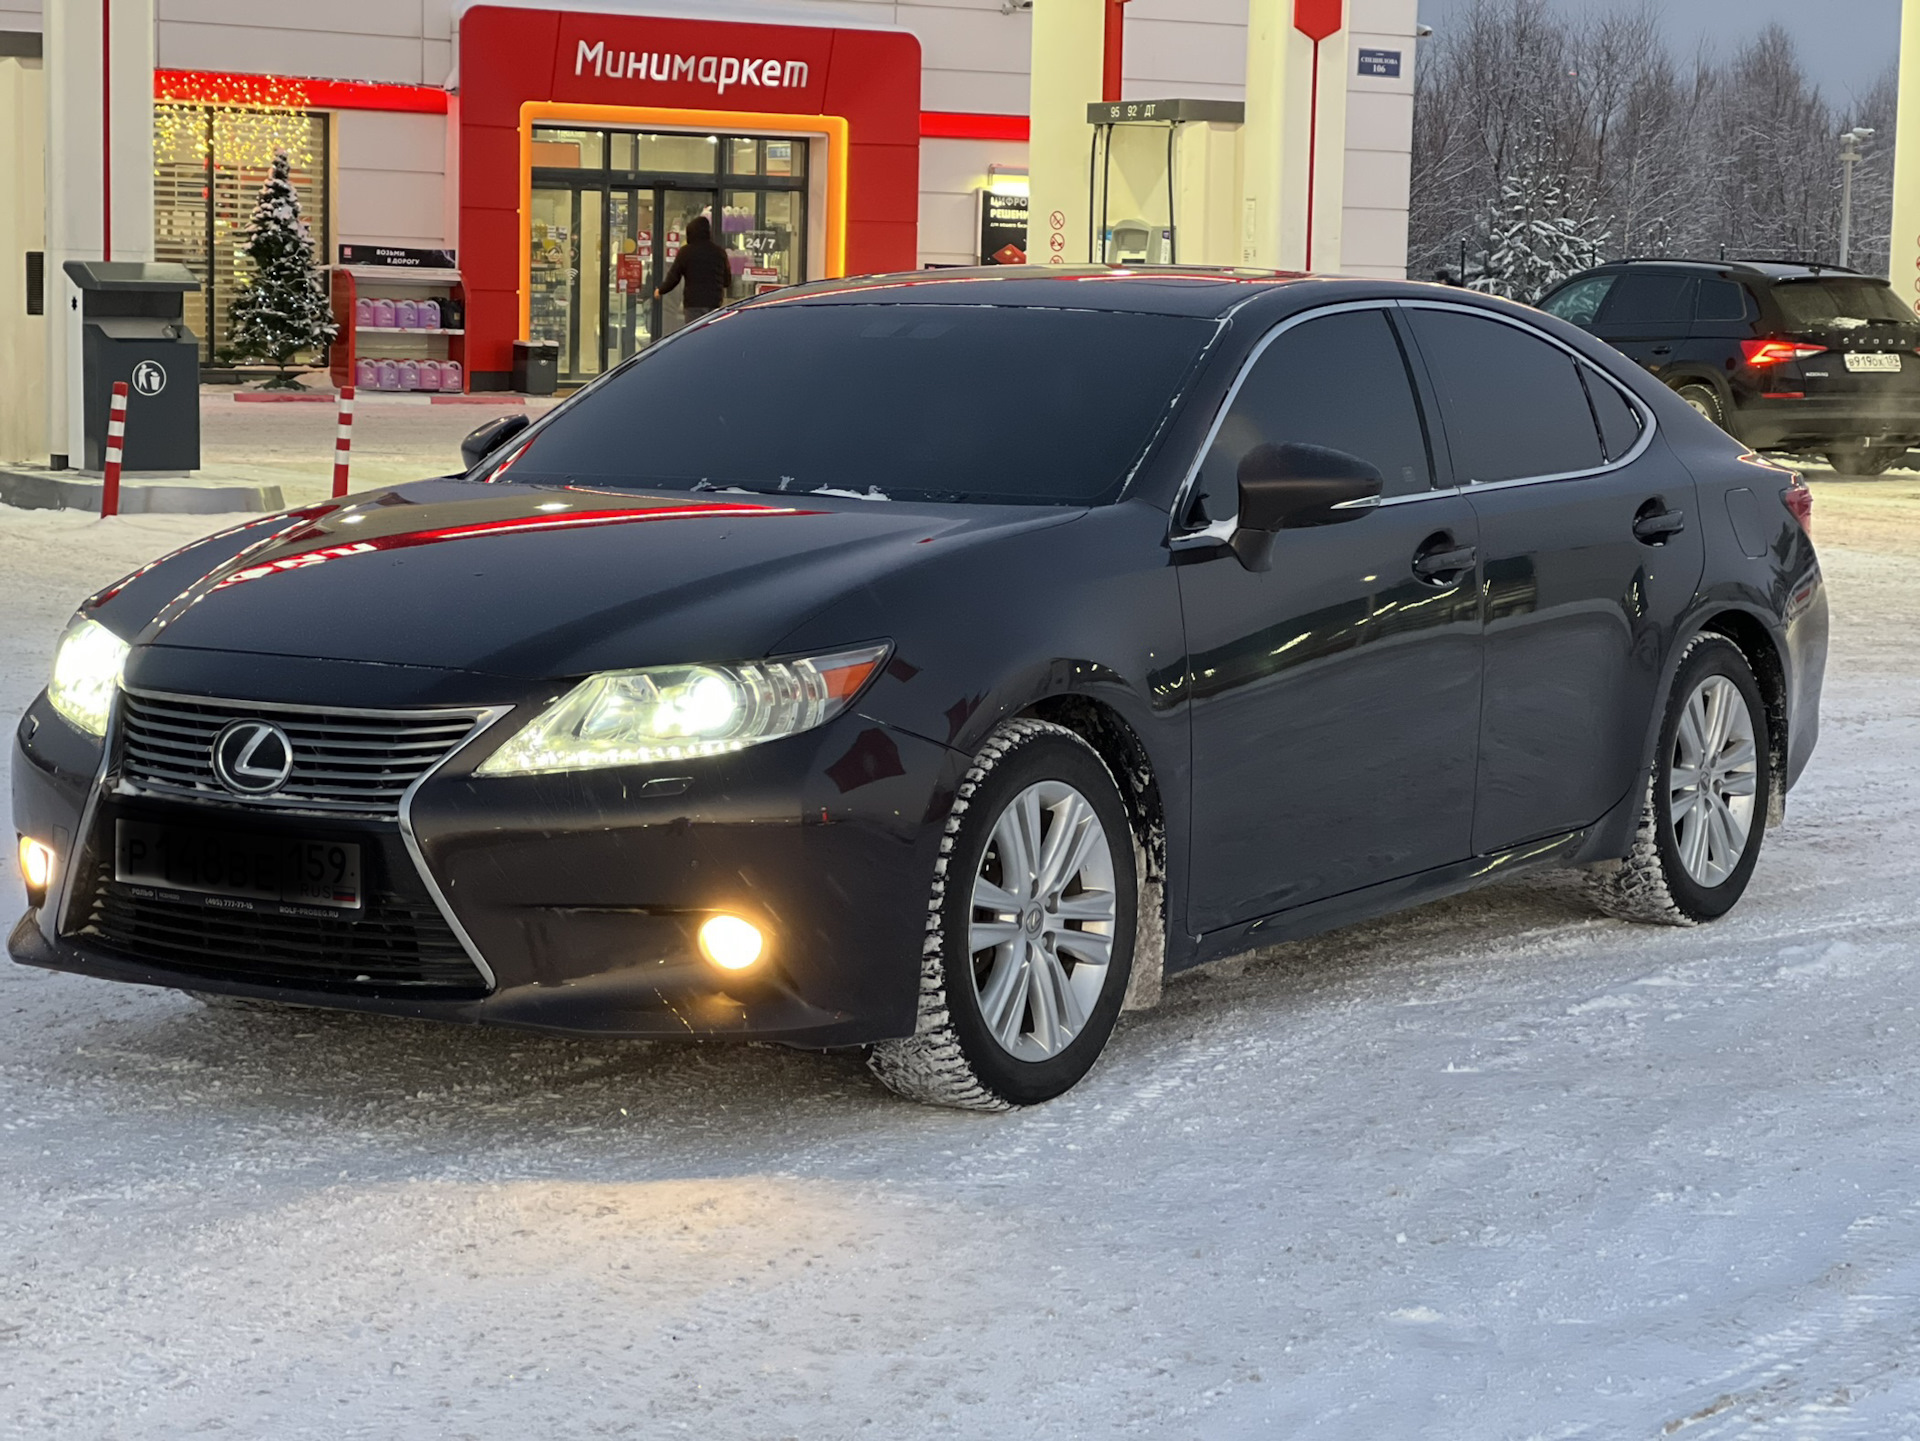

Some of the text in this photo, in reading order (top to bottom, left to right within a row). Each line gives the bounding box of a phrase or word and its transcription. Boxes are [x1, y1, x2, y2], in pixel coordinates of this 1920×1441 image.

[575, 40, 808, 95] Минимаркет
[1373, 64, 1386, 73] 106
[1110, 104, 1156, 118] 95 92 ДТ
[745, 237, 776, 250] 24/7
[376, 249, 405, 257] ВОЗЬМИ
[392, 257, 420, 265] ДОРОГУ
[288, 843, 346, 884] 159
[301, 882, 331, 899] RUS
